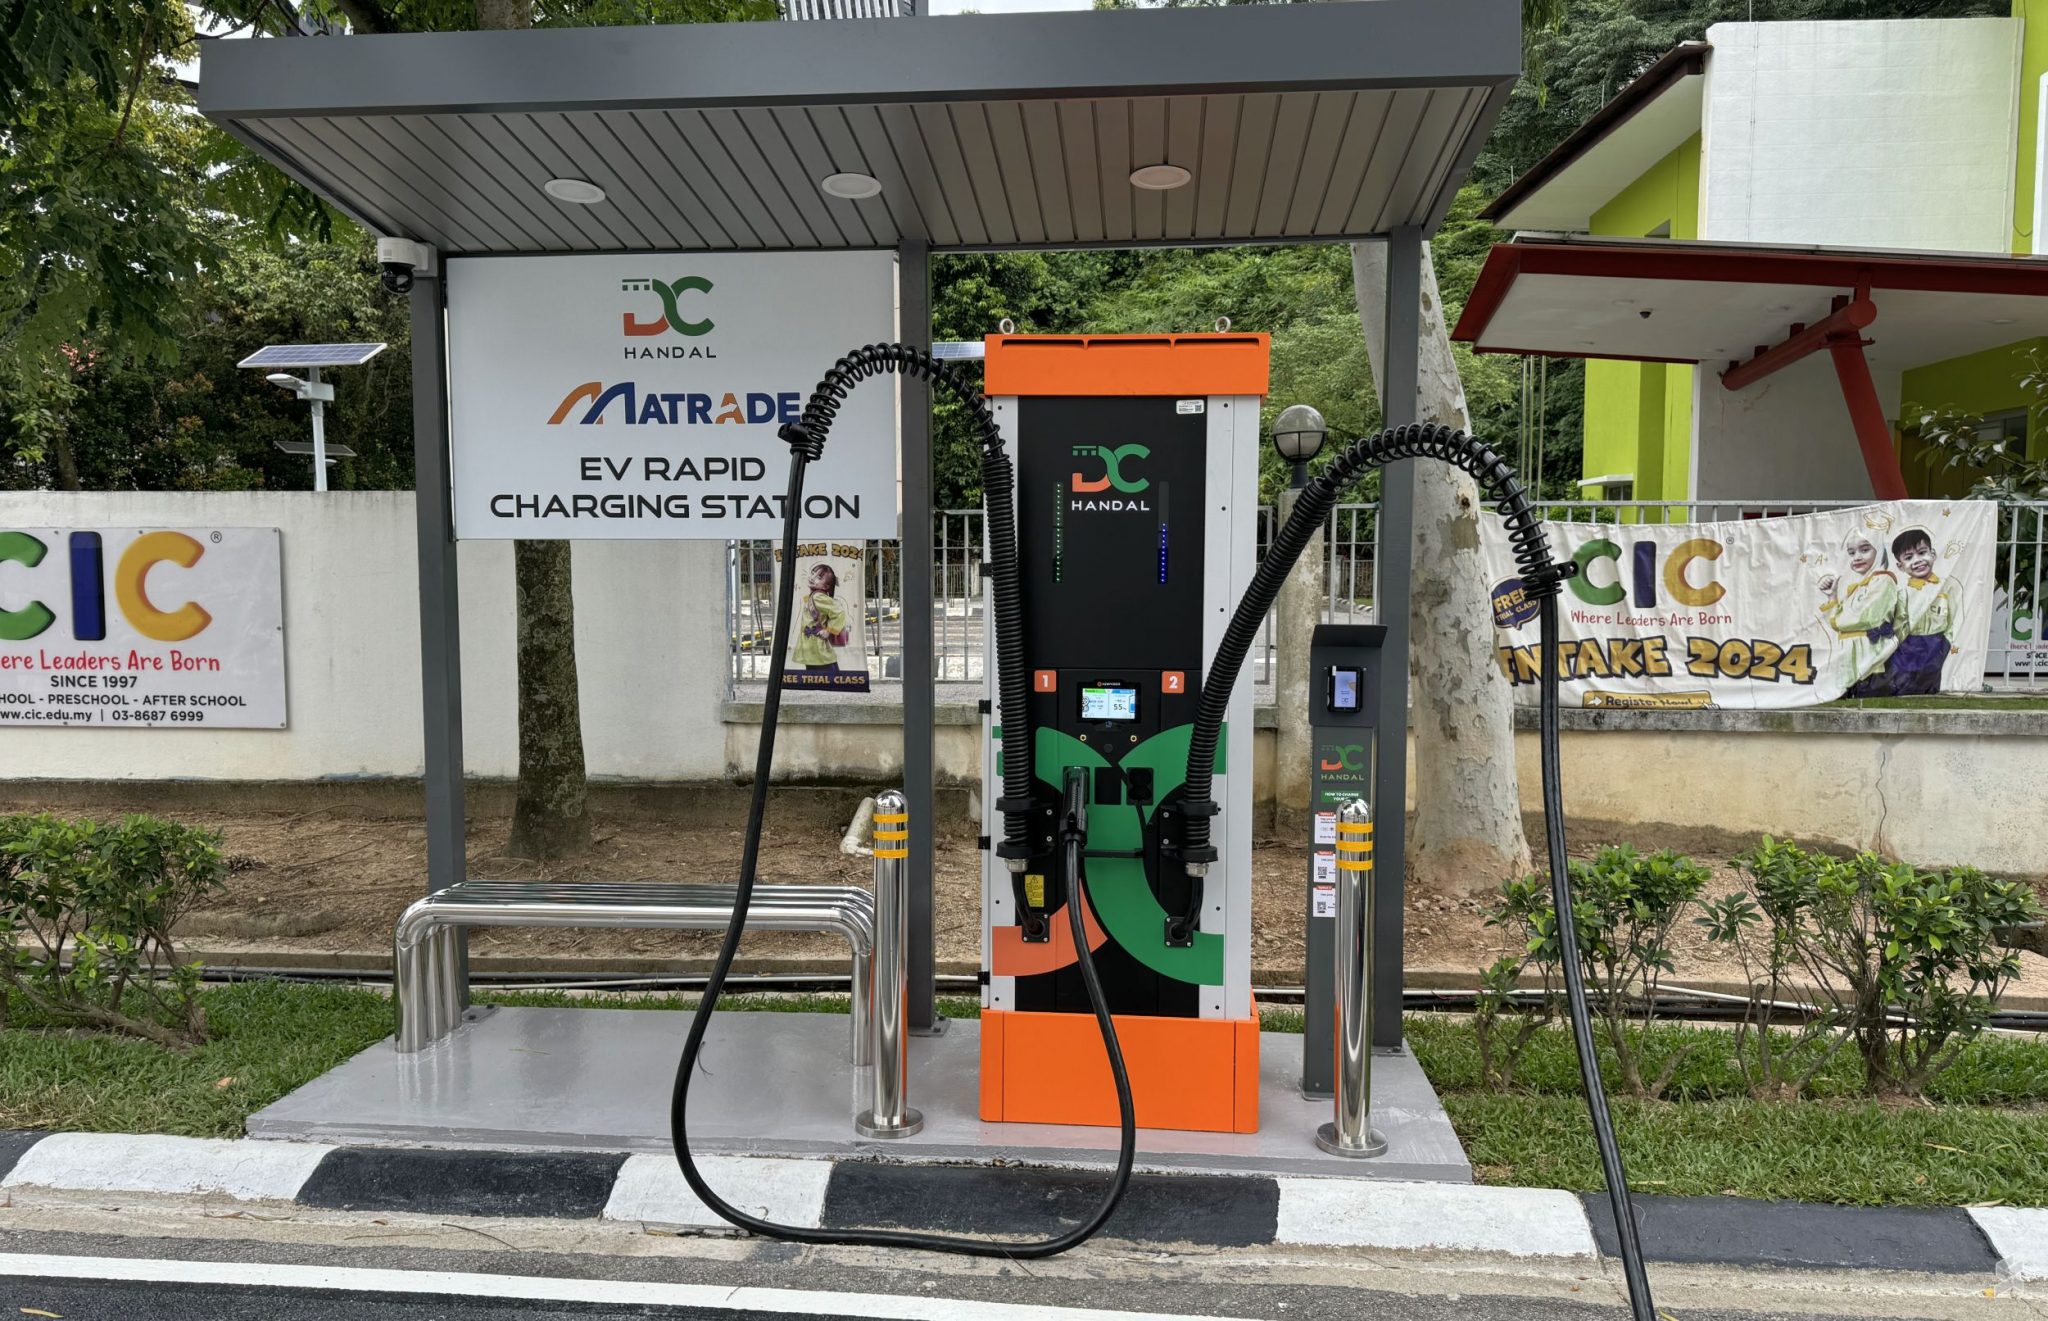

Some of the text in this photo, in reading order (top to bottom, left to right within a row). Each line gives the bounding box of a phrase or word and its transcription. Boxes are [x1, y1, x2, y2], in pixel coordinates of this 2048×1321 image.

[624, 346, 716, 359] HANDAL
[546, 381, 801, 424] MATRADE
[580, 457, 766, 481] EV RAPID
[490, 494, 860, 519] CHARGING STATON
[1071, 500, 1150, 511] HANDAL
[1567, 538, 1727, 608] CIC
[1515, 600, 1537, 613] CLASS
[1571, 610, 1732, 626] Where Leaders Are Born
[0, 649, 220, 671] ere Leaders Are Born
[1685, 636, 1817, 684] 2024
[50, 675, 137, 688] SINCE 1997
[782, 675, 865, 684] REE TRIAL CLASS
[1042, 674, 1049, 688] 1
[1169, 675, 1178, 689] 2
[0, 693, 35, 704] HOOL
[48, 694, 129, 705] PRESCHOOL
[143, 695, 186, 706] AFTER
[190, 695, 247, 706] SCHOOL
[1606, 696, 1656, 708] Register
[0, 708, 92, 722] ww.cic.edu.my
[112, 711, 166, 721] 03-8687
[170, 711, 204, 721] 6999
